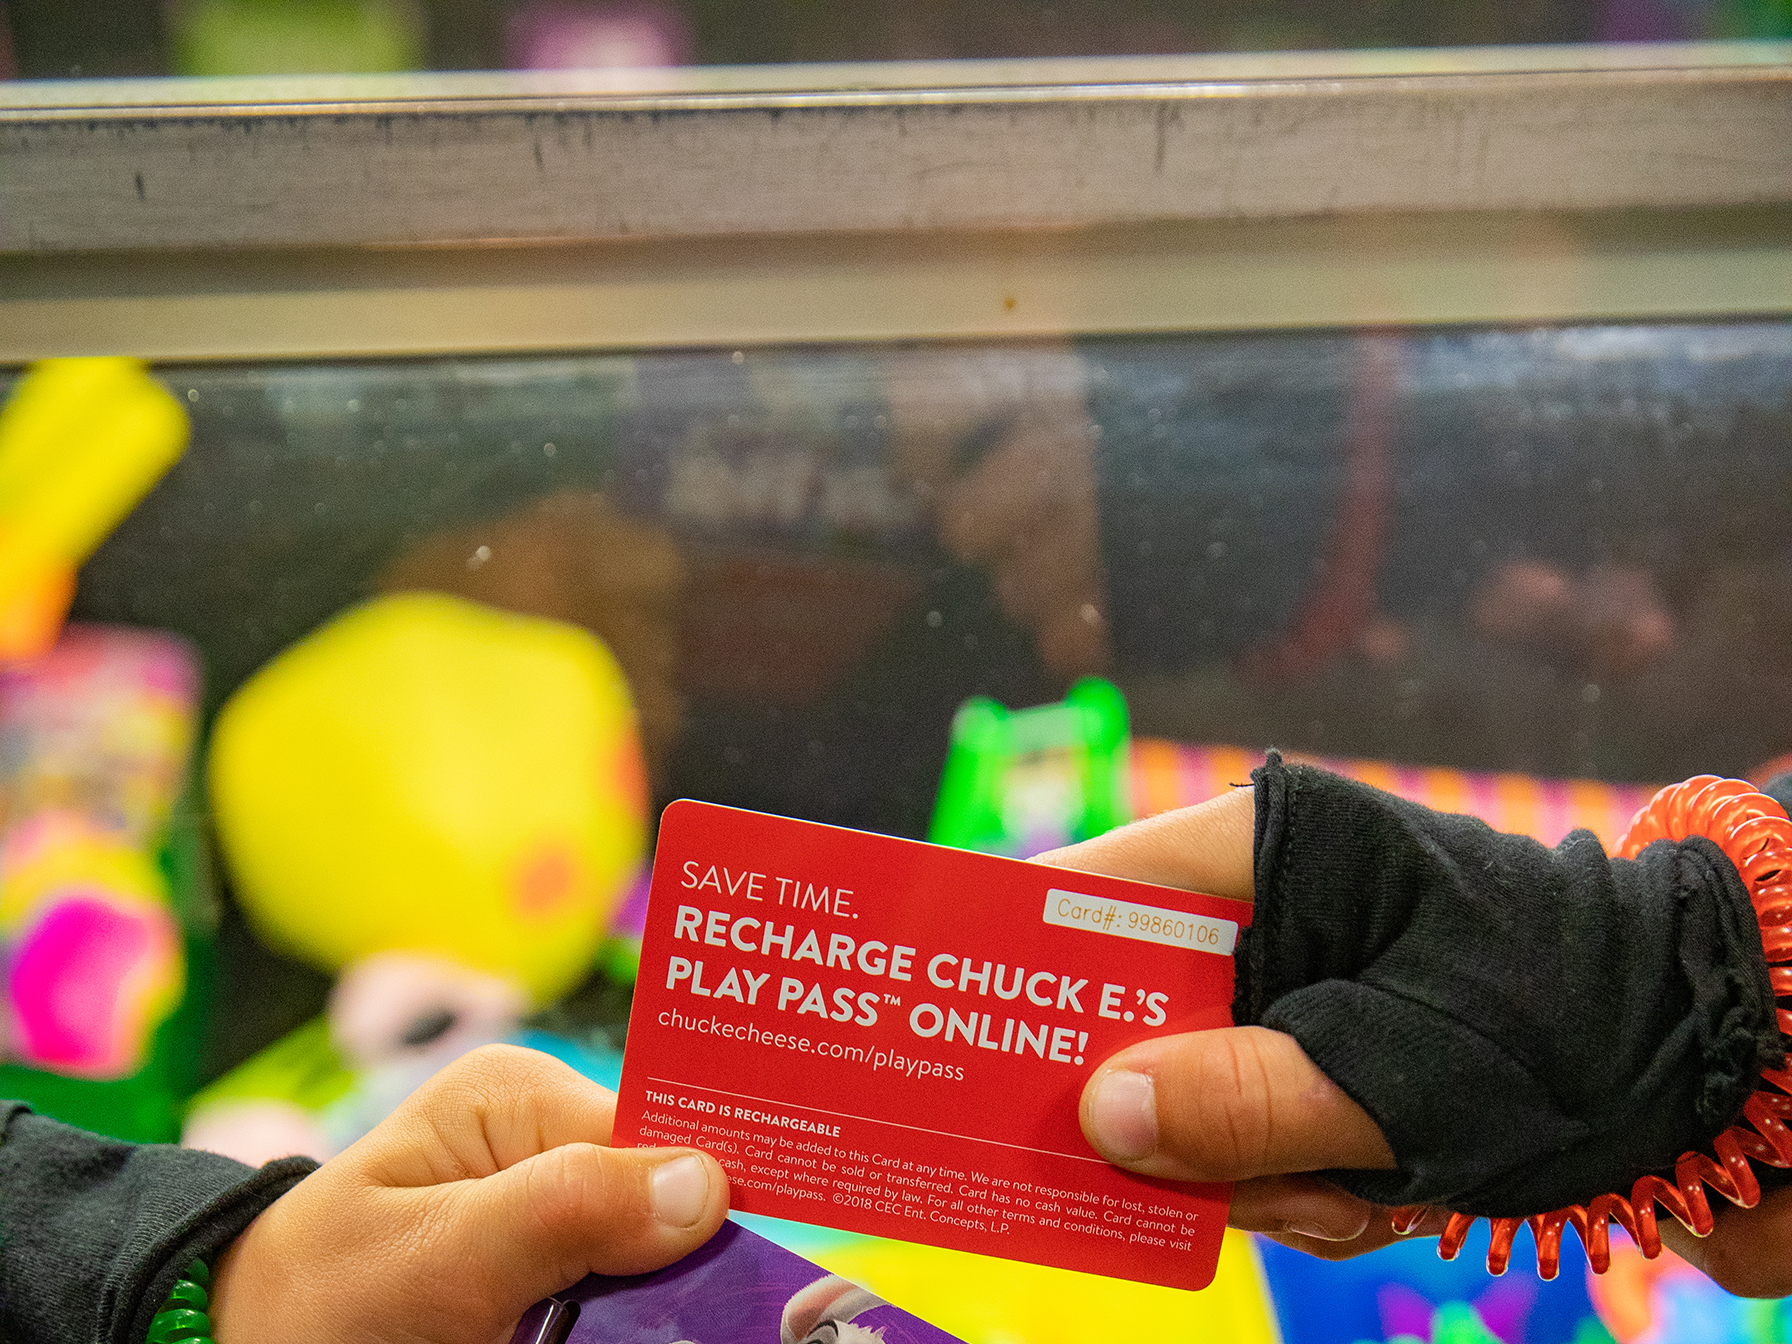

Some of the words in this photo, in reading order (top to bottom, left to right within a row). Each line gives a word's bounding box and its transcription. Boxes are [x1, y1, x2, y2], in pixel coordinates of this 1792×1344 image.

[680, 860, 767, 901] SAVE
[775, 876, 859, 919] TIME.
[1057, 898, 1122, 931] Card#:
[1128, 911, 1220, 945] 99860106
[673, 904, 917, 982] RECHARGE
[927, 953, 1089, 1014] CHUCK
[658, 1007, 964, 1081] chuckecheese.com/playpass
[665, 955, 771, 1005] PLAY
[909, 1002, 1089, 1066] ONLINE!
[645, 1090, 675, 1106] THIS
[677, 1096, 716, 1114] CARD
[718, 1104, 731, 1117] IS
[733, 1107, 841, 1138] RECHARGEABLE
[639, 1125, 692, 1145] damaged
[695, 1135, 740, 1155] Card(s).
[744, 1145, 774, 1161] Card
[777, 1154, 817, 1169] cannot
[821, 1159, 837, 1173] be
[841, 1165, 866, 1178] sold
[869, 1171, 883, 1180] or
[886, 1172, 954, 1194] transferred.
[958, 1184, 988, 1200] Card
[991, 1190, 1011, 1204] has
[1015, 1197, 1031, 1208] no
[1035, 1201, 1061, 1213] cash
[1065, 1206, 1098, 1220] value.
[1103, 1210, 1132, 1225] Card
[1135, 1219, 1176, 1233] cannot
[1180, 1224, 1195, 1237] be
[641, 1110, 700, 1131] Additional
[700, 1124, 751, 1141] amounts
[752, 1134, 778, 1148] may
[778, 1135, 794, 1149] be
[795, 1140, 832, 1156] added
[833, 1147, 847, 1159] to
[848, 1149, 869, 1163] this
[871, 1153, 901, 1169] Card
[901, 1161, 914, 1172] at
[915, 1164, 938, 1178] any
[938, 1166, 968, 1181] time.
[971, 1170, 990, 1185] We
[991, 1178, 1011, 1189] are
[1012, 1181, 1033, 1193] not
[1034, 1186, 1100, 1205] responsible
[1102, 1194, 1120, 1207] for
[1121, 1198, 1145, 1213] lost,
[1148, 1205, 1183, 1219] stolen
[1185, 1212, 1199, 1221] or
[718, 1158, 747, 1173] cash,
[750, 1164, 790, 1180] except
[793, 1171, 829, 1187] where
[832, 1180, 881, 1196] required
[884, 1186, 899, 1202] by
[901, 1189, 923, 1204] law.
[927, 1194, 948, 1208] For
[950, 1199, 964, 1211] all
[966, 1203, 999, 1217] other
[1002, 1209, 1035, 1224] terms
[1038, 1217, 1061, 1229] and
[1063, 1221, 1126, 1241] conditions,
[1129, 1231, 1166, 1247] please
[1169, 1238, 1191, 1252] visit
[727, 1176, 826, 1202] ese.com/playpass.
[874, 1200, 902, 1215] CEC
[904, 1205, 927, 1220] Ent.
[929, 1210, 987, 1232] Concepts,
[990, 1221, 1010, 1235] L.P.
